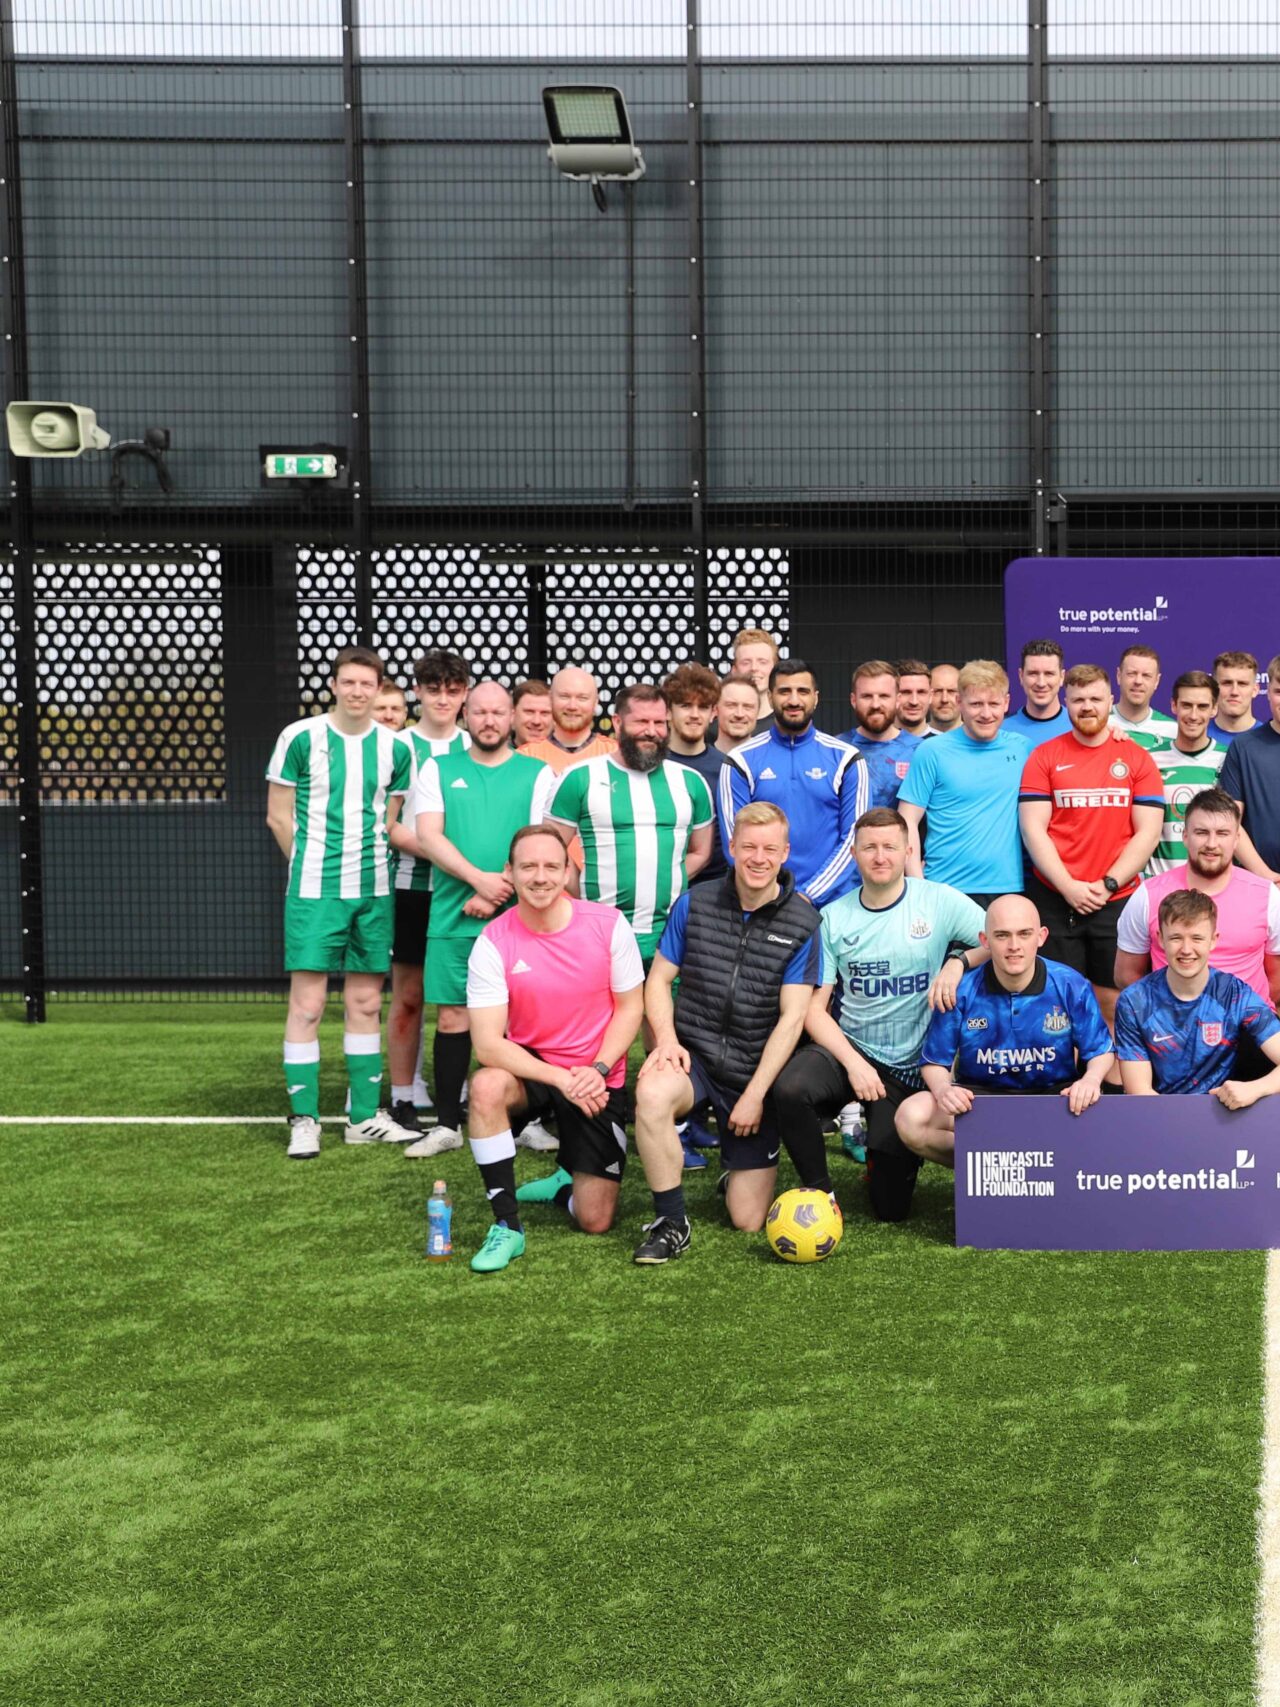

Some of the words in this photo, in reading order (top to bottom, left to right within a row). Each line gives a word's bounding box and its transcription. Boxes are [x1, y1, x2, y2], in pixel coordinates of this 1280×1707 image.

[1059, 607, 1087, 621] true
[1090, 607, 1157, 623] potential
[1102, 626, 1116, 634] your
[1117, 626, 1140, 634] money.
[1053, 788, 1131, 808] PIRELLI
[848, 960, 891, 977] 乐天堂
[849, 972, 930, 998] FUN88
[988, 1063, 1044, 1074] LAGER
[982, 1151, 1054, 1167] NEWCASTLE
[982, 1166, 1026, 1182] UNITED
[1076, 1169, 1123, 1190] true
[1127, 1168, 1237, 1195] potential
[982, 1181, 1055, 1196] FOUNDATION
